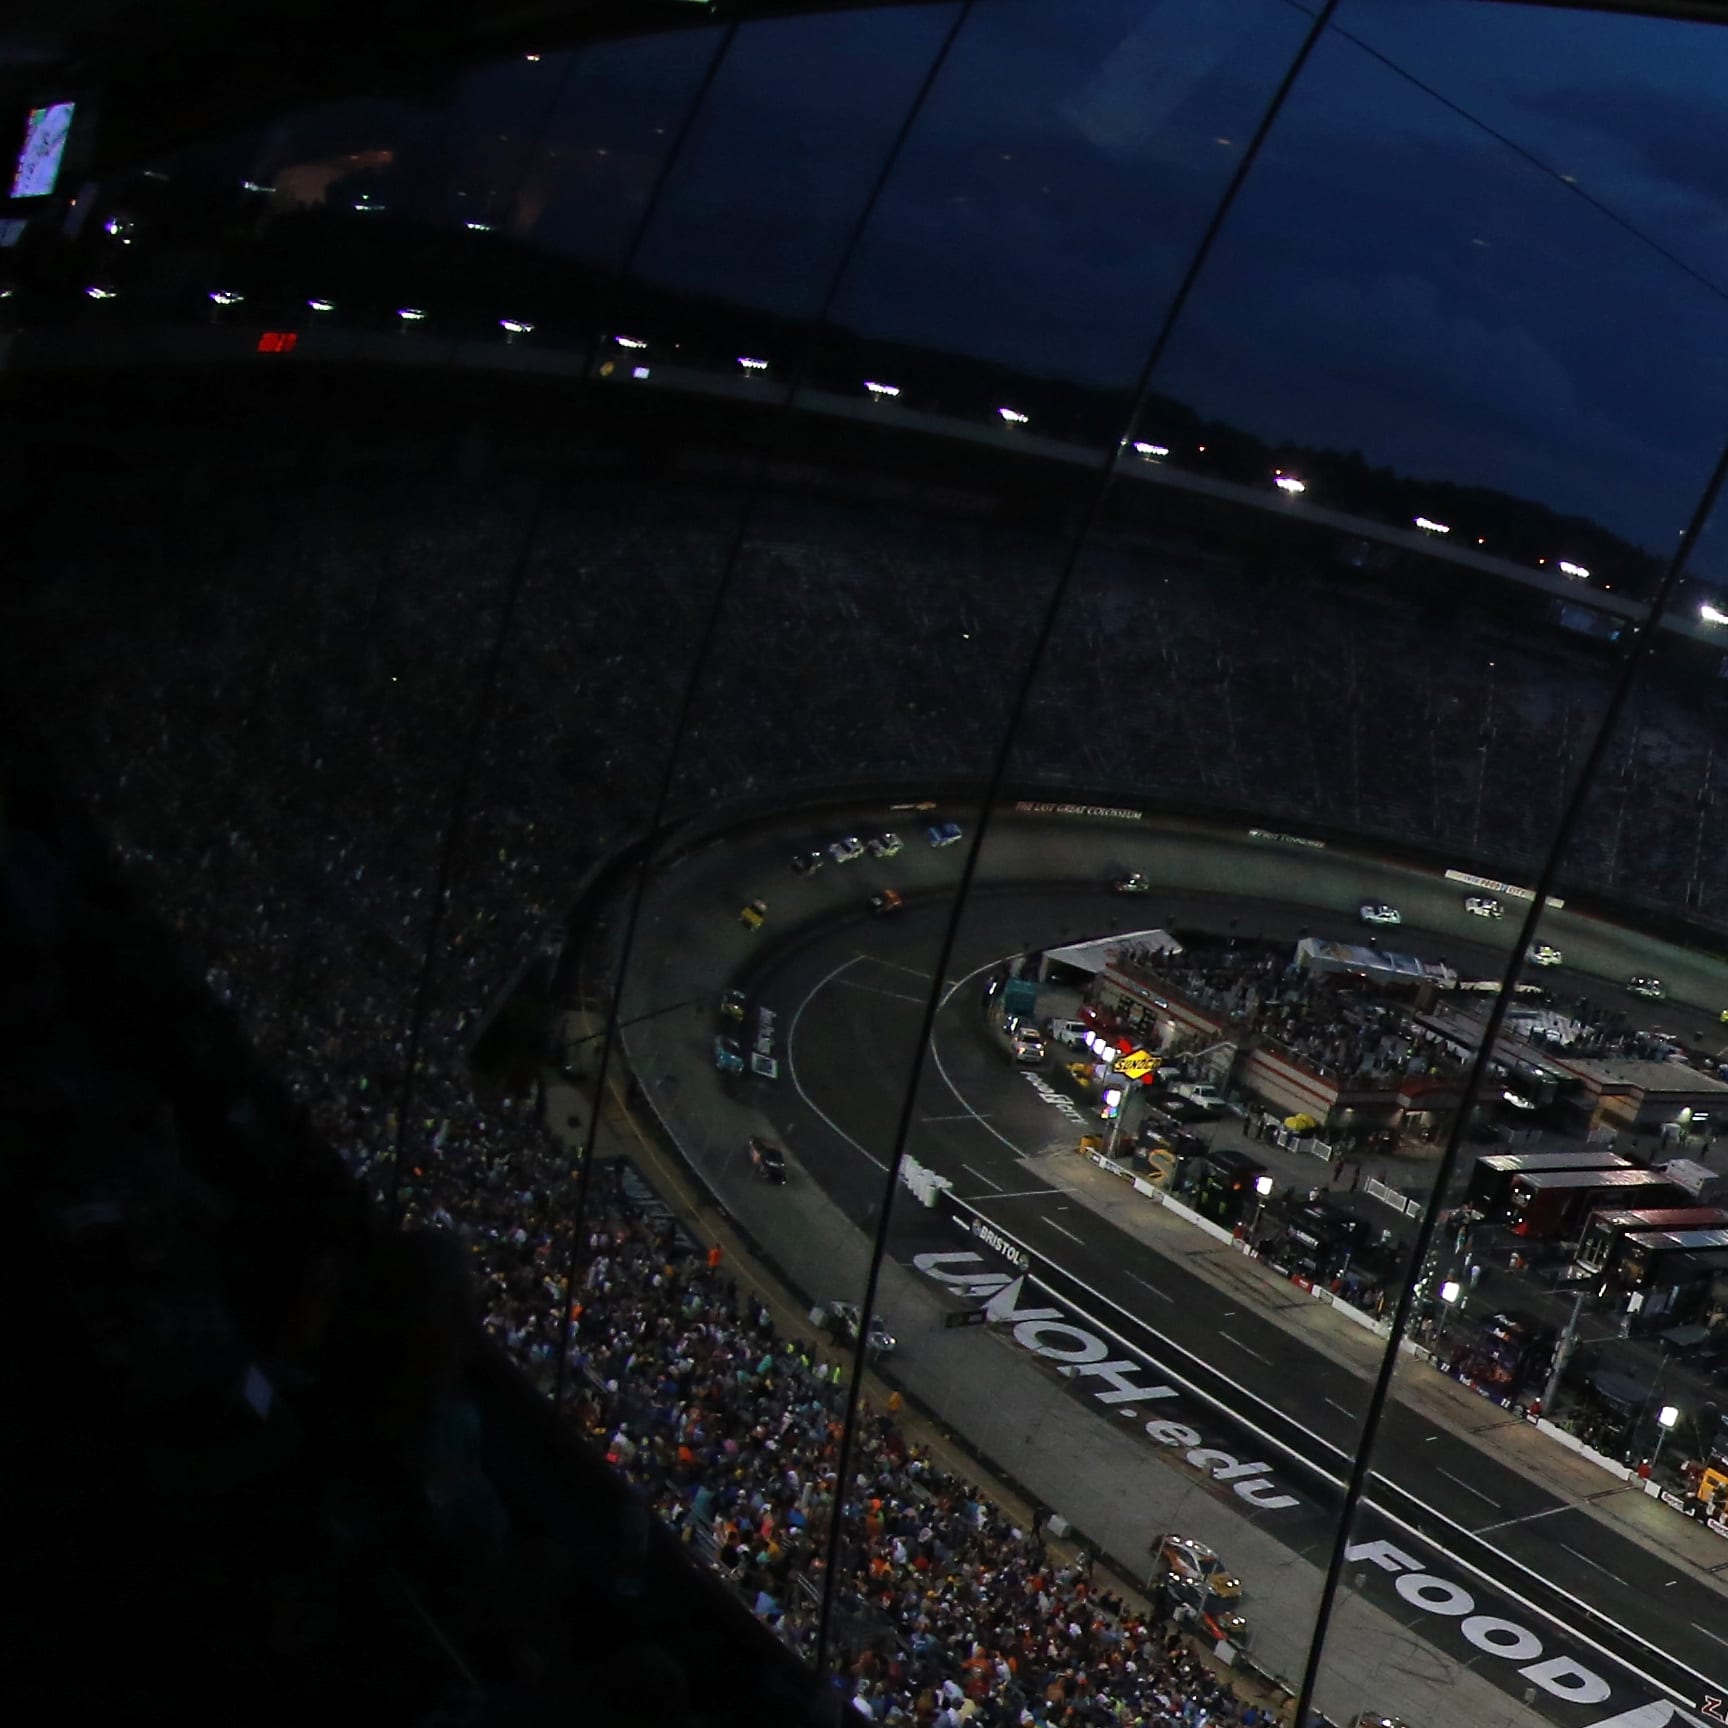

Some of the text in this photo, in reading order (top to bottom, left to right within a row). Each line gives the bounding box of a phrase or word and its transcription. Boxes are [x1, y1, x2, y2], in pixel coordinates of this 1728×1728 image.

[977, 1225, 1022, 1266] BRISTOL
[913, 1250, 1301, 1510] UNOH.edu
[1347, 1538, 1612, 1705] FOOD
